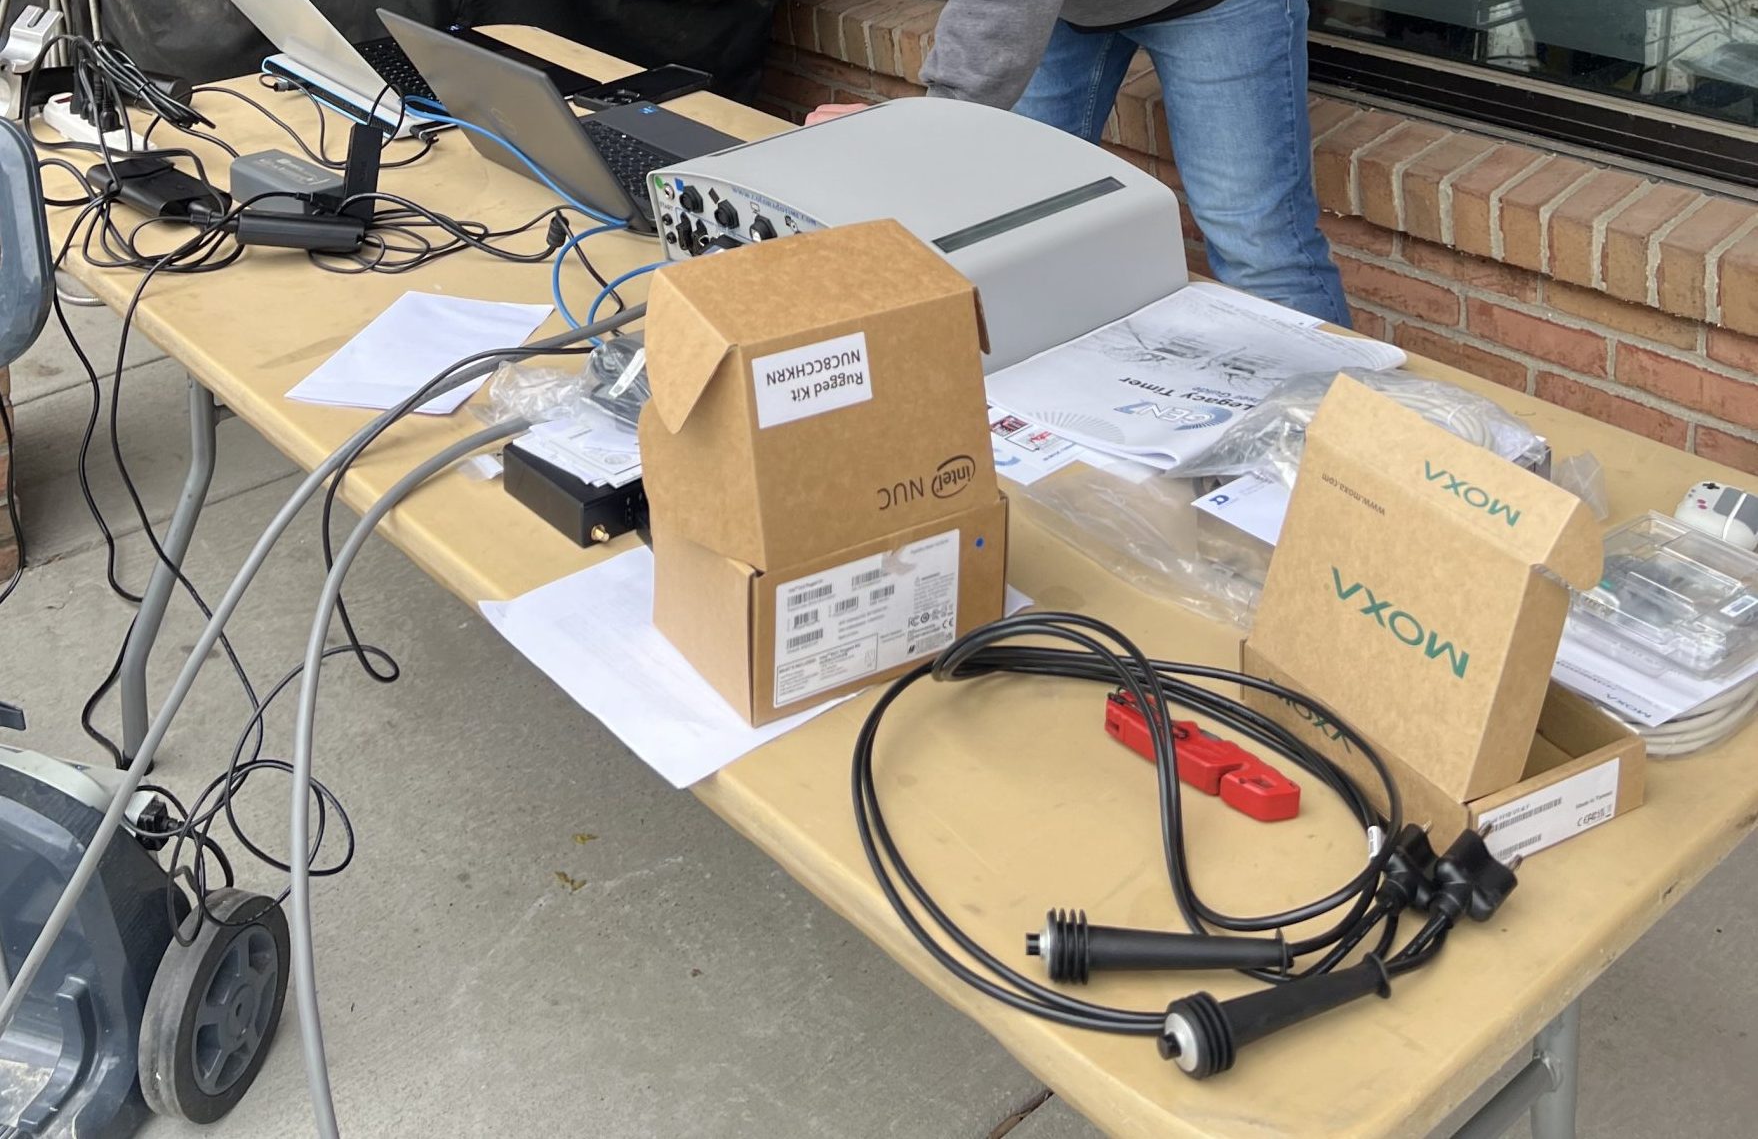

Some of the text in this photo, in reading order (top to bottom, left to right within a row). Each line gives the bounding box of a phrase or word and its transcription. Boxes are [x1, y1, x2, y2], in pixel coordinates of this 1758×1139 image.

[766, 349, 861, 386] NUC8CCHKRN
[790, 371, 864, 402] Rugged Kit
[1118, 377, 1256, 411] Legacy Timer
[1191, 386, 1232, 398] Guide
[877, 461, 973, 511] intel NUC
[1321, 472, 1386, 517] www.moxa.com
[1425, 459, 1521, 527] MOXA
[1331, 564, 1470, 680] MOXA
[1606, 693, 1652, 718] MOXA
